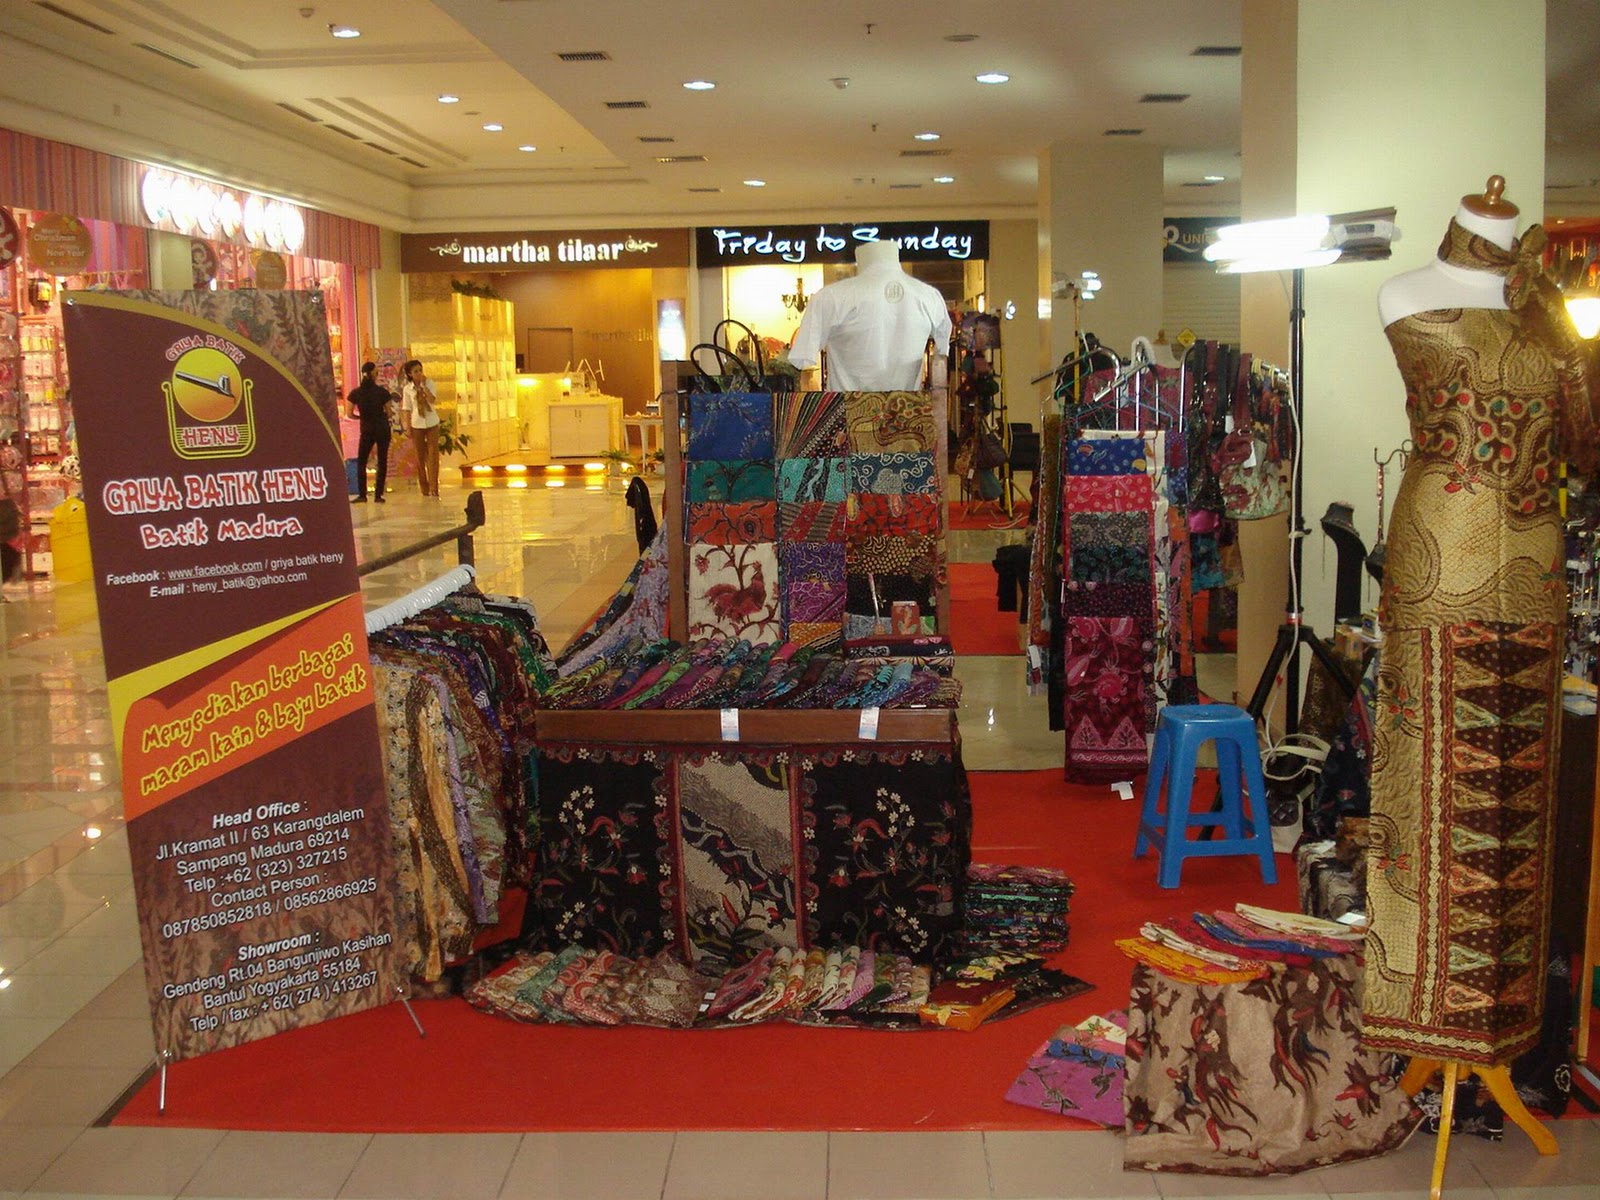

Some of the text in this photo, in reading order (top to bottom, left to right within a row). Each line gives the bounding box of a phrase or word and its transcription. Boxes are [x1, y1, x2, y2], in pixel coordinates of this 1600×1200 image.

[463, 238, 624, 262] martha tilaar
[713, 229, 806, 262] Friday
[816, 226, 846, 252] to
[165, 335, 246, 364] GRIYA BATIK
[182, 426, 239, 447] HENY
[103, 466, 328, 514] GRIYA BATIK HENY
[140, 513, 302, 549] Batik Madura
[107, 570, 160, 586] Facebook
[168, 560, 262, 580] www.facebook.com
[271, 558, 294, 572] griya
[296, 554, 318, 566] batik
[320, 552, 344, 565] heny
[150, 582, 184, 598] E-mail
[192, 572, 307, 594] heny_batik@yahoo.com
[142, 634, 354, 752] Menyediakan berbagai
[140, 663, 366, 796] macam kain & baju batik
[212, 808, 252, 829] Head
[256, 802, 300, 820] Office
[252, 824, 270, 840] 63
[274, 808, 364, 836] Karangdalem
[176, 828, 350, 875] Sampang Madura 69214
[184, 876, 216, 893] Telp
[256, 858, 292, 880] (323)
[296, 846, 348, 870] 327215
[163, 902, 272, 938] 087850852818
[284, 878, 377, 910] 08562866925
[212, 884, 268, 907] Contact
[270, 874, 320, 894] Person
[164, 933, 392, 998] Gendeng Rt.04 Bangunjiwo Kasihan
[238, 934, 312, 961] Showroom
[204, 957, 361, 1009] Bantul Yogyakarta 55184
[190, 1014, 218, 1032] Telp
[228, 1007, 250, 1021] fax
[332, 971, 378, 994] 413267
